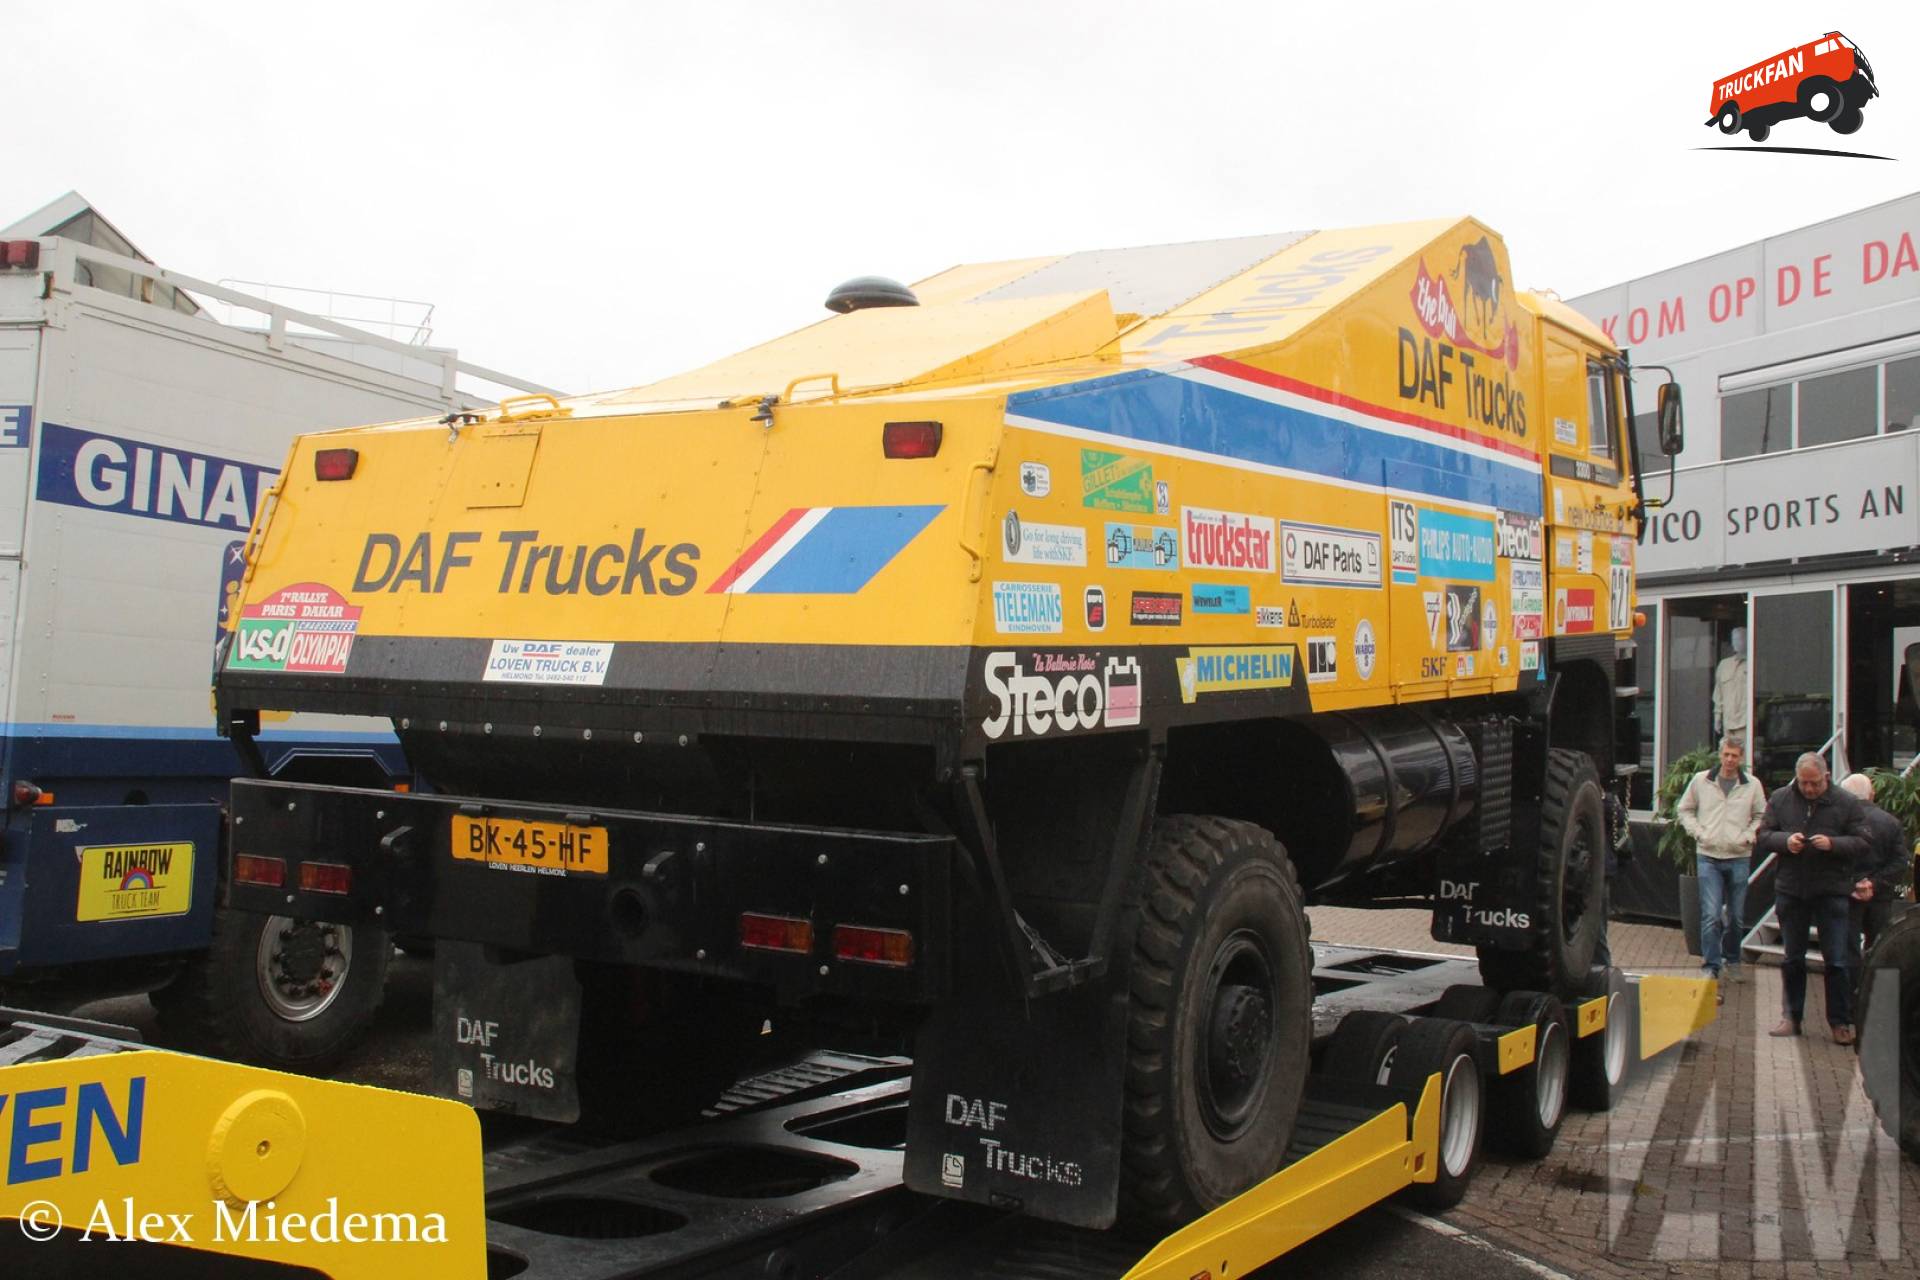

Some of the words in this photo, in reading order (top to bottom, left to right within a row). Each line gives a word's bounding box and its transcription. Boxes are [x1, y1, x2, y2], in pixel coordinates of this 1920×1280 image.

[1709, 277, 1756, 324] OP
[1777, 254, 1832, 307] DE
[1863, 231, 1920, 285] DA
[1399, 325, 1453, 410] DAF
[1459, 350, 1527, 438] Trucks
[1392, 501, 1415, 542] ITS
[1727, 494, 1840, 536] SPORTS
[1860, 485, 1904, 519] AN
[1187, 510, 1271, 570] truckstar
[1422, 528, 1450, 560] PHILIPS
[352, 531, 482, 594] DAF
[498, 528, 701, 596] Trucks
[1304, 541, 1329, 570] DAF
[1333, 544, 1362, 574] Parts
[261, 605, 297, 617] PARIS
[301, 606, 344, 618] DAKAR
[291, 592, 329, 604] RALLYE
[994, 592, 1062, 623] TIELEMANS
[1008, 624, 1052, 633] EINDHOVEN
[1301, 614, 1338, 630] Turbolader
[238, 621, 294, 661] vsd
[290, 633, 348, 666] OLYMPIA
[502, 644, 519, 654] Uw
[523, 643, 562, 653] DAF
[566, 645, 602, 656] dealer
[1355, 644, 1375, 655] WABCO
[490, 658, 532, 671] LOVEN
[535, 659, 578, 673] TRUCK
[581, 660, 605, 674] B.V.
[502, 672, 534, 681] HELMOND
[1197, 652, 1292, 684] MICHELIN
[1421, 656, 1448, 678] SKF
[982, 651, 1103, 739] Steco
[469, 823, 593, 864] BK-45-HF
[103, 847, 173, 879] RAINBOW
[112, 893, 137, 910] TRUCK
[139, 891, 160, 909] TEAM
[457, 1017, 499, 1047] DAF
[480, 1052, 555, 1089] Trucks
[945, 1093, 1008, 1131] DAF
[0, 1076, 146, 1186] EN
[980, 1137, 1083, 1186] Trucks
